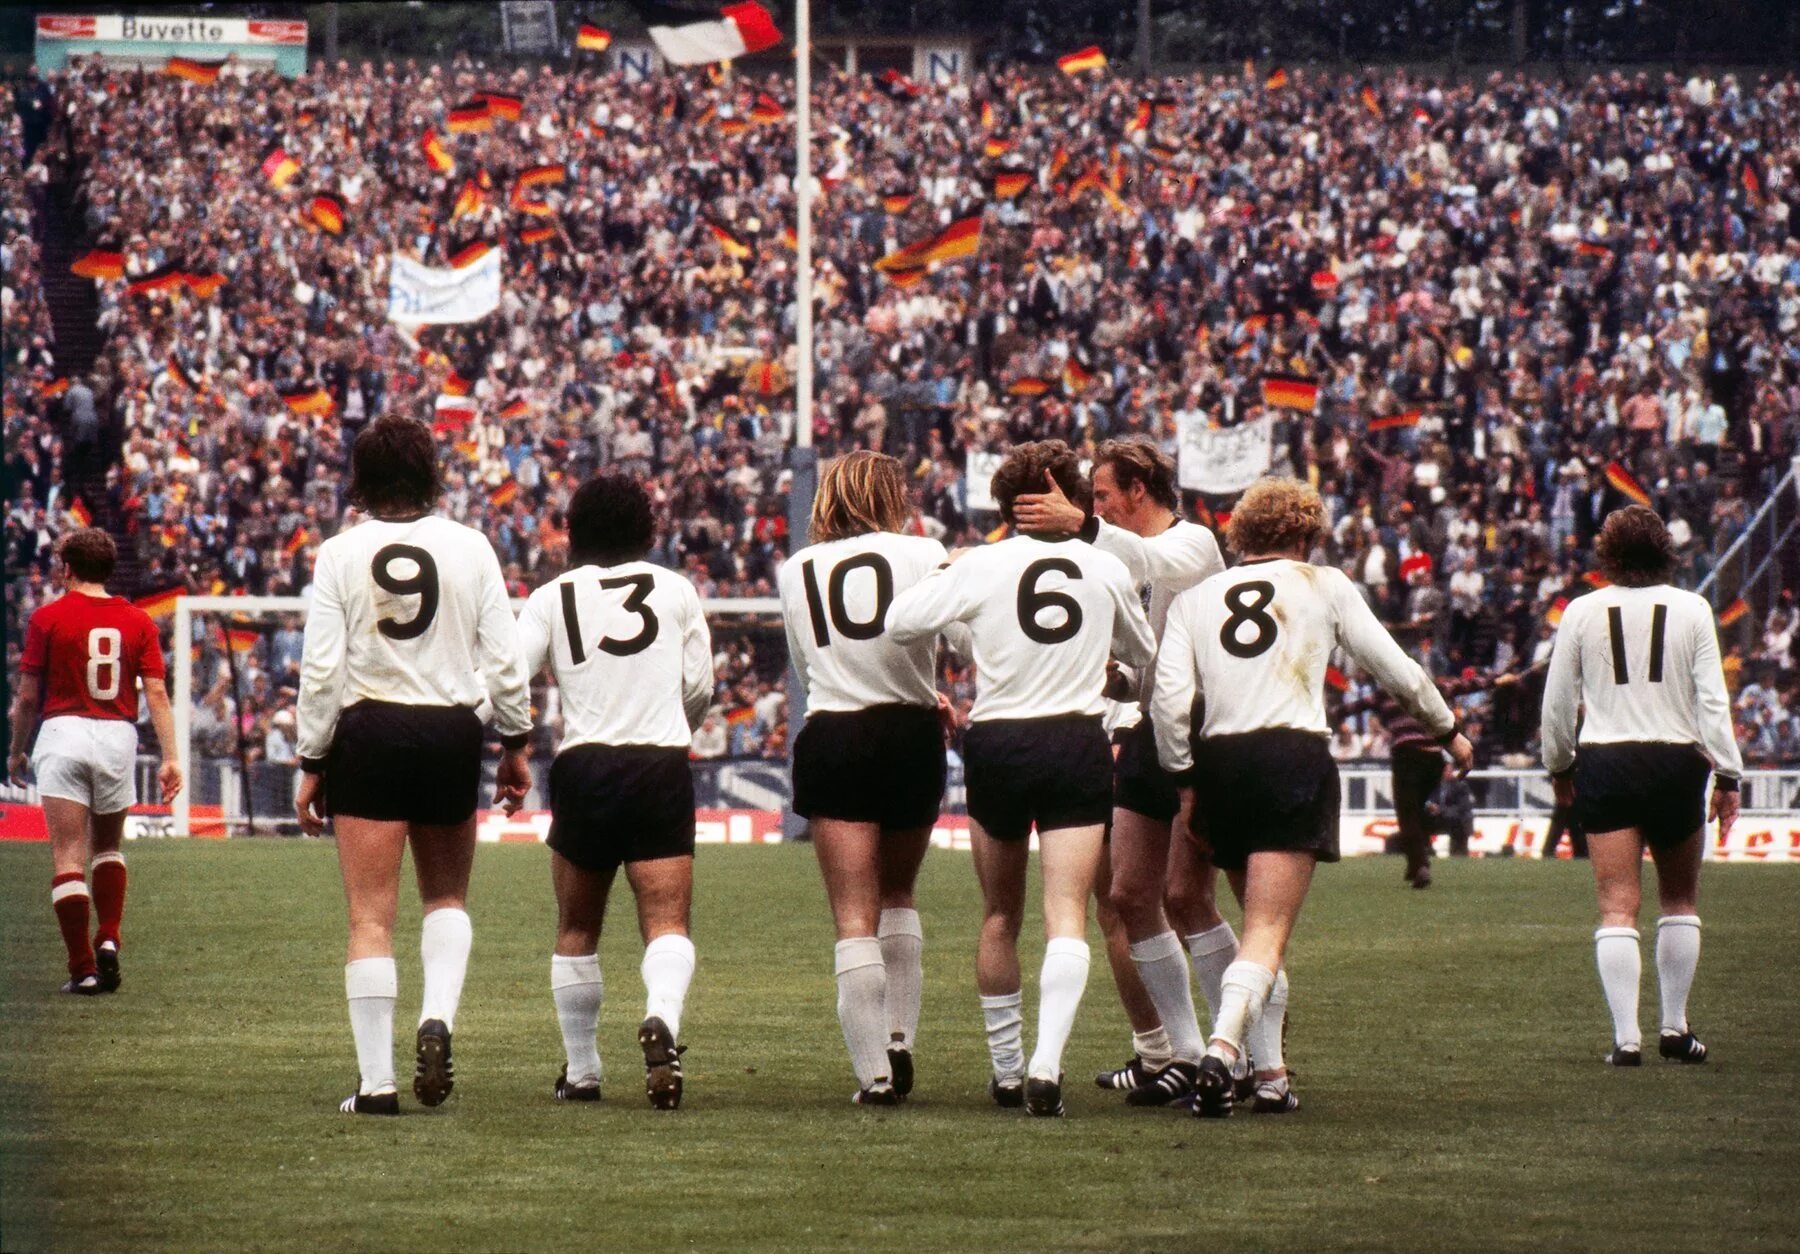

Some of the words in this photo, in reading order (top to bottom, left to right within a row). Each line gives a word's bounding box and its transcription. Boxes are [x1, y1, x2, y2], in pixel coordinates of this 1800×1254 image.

[123, 17, 223, 41] Buvette
[930, 53, 958, 81] N
[371, 543, 440, 641] 9
[560, 573, 659, 666] 13
[802, 552, 894, 648] 10
[1017, 558, 1083, 645] 6
[1219, 580, 1278, 659] 8
[87, 627, 122, 700] 8
[1608, 604, 1667, 685] 11
